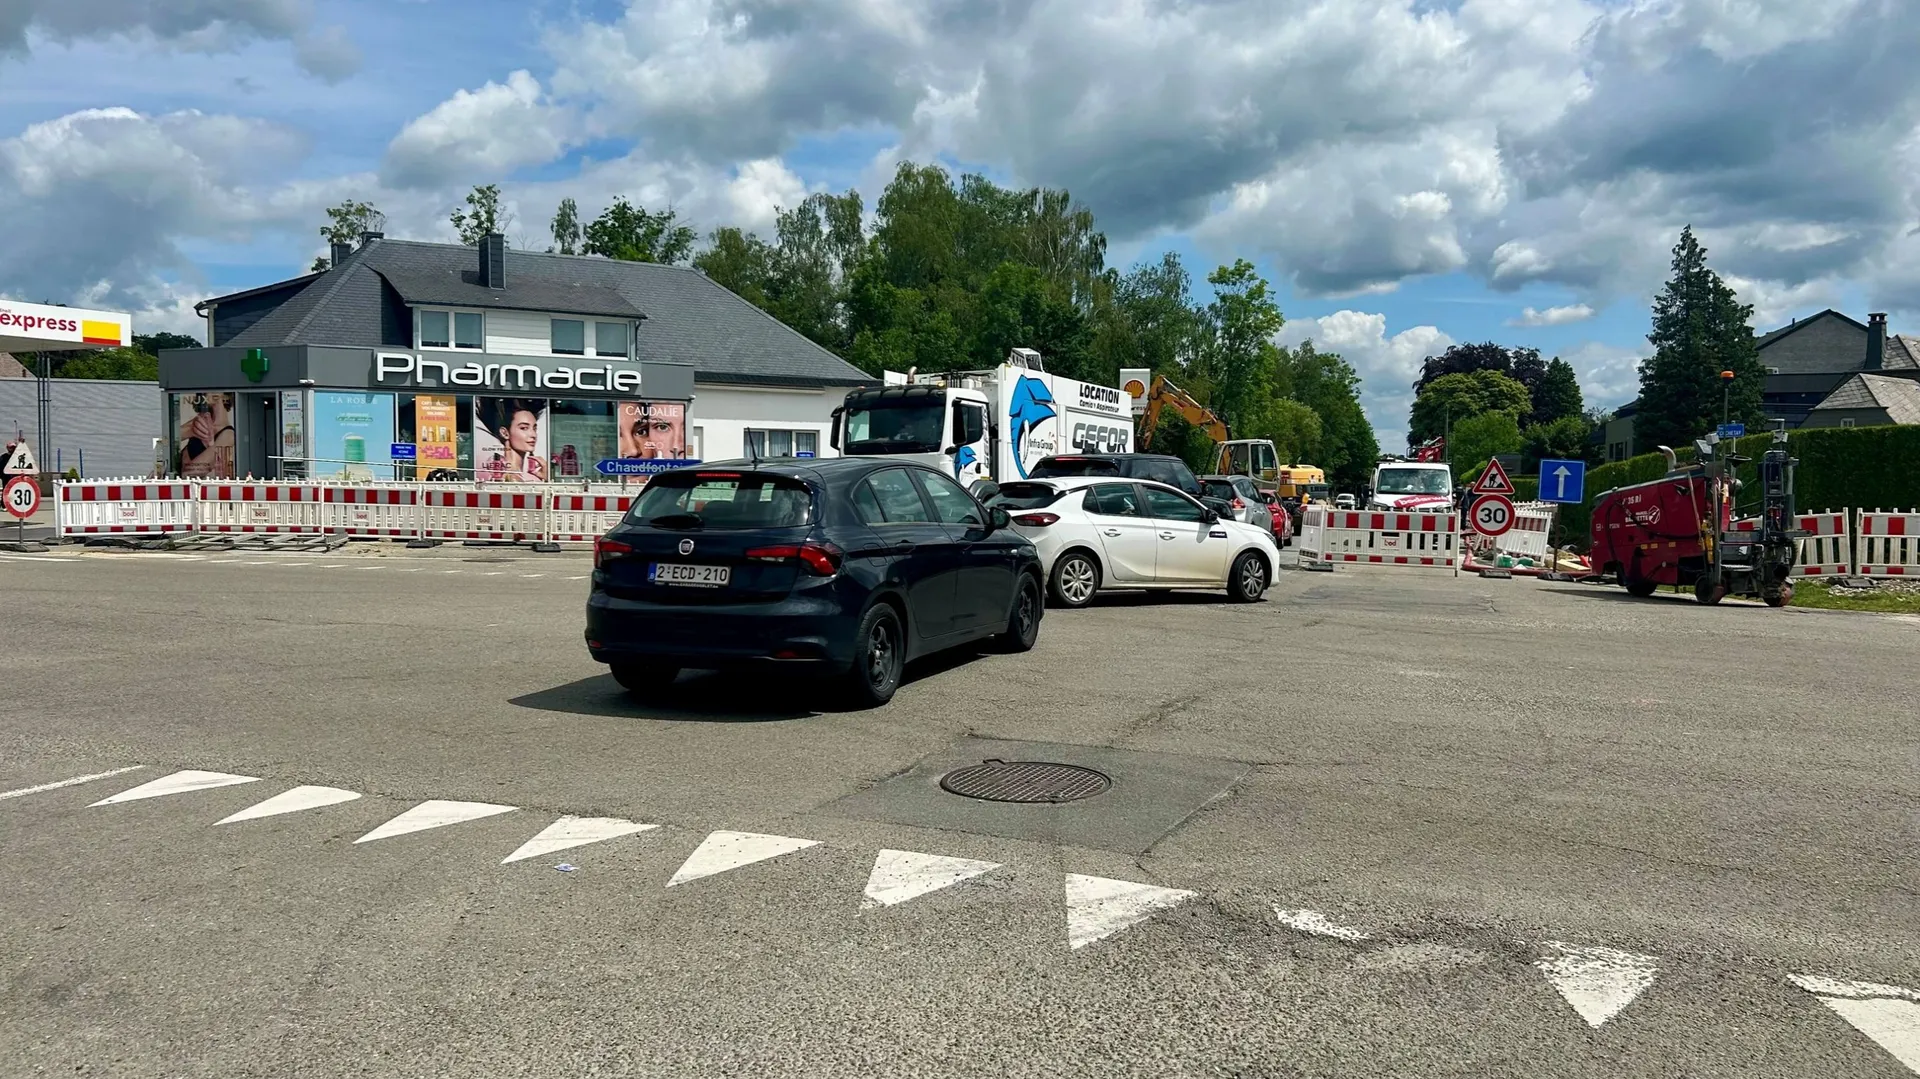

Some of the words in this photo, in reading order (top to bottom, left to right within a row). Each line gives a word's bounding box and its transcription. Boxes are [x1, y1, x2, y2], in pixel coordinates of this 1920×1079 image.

[0, 313, 77, 332] express
[376, 352, 642, 392] Pharmacie
[1079, 384, 1119, 404] LOCATION
[1072, 423, 1129, 453] GEFOR
[14, 489, 31, 506] 30
[1480, 507, 1506, 524] 30
